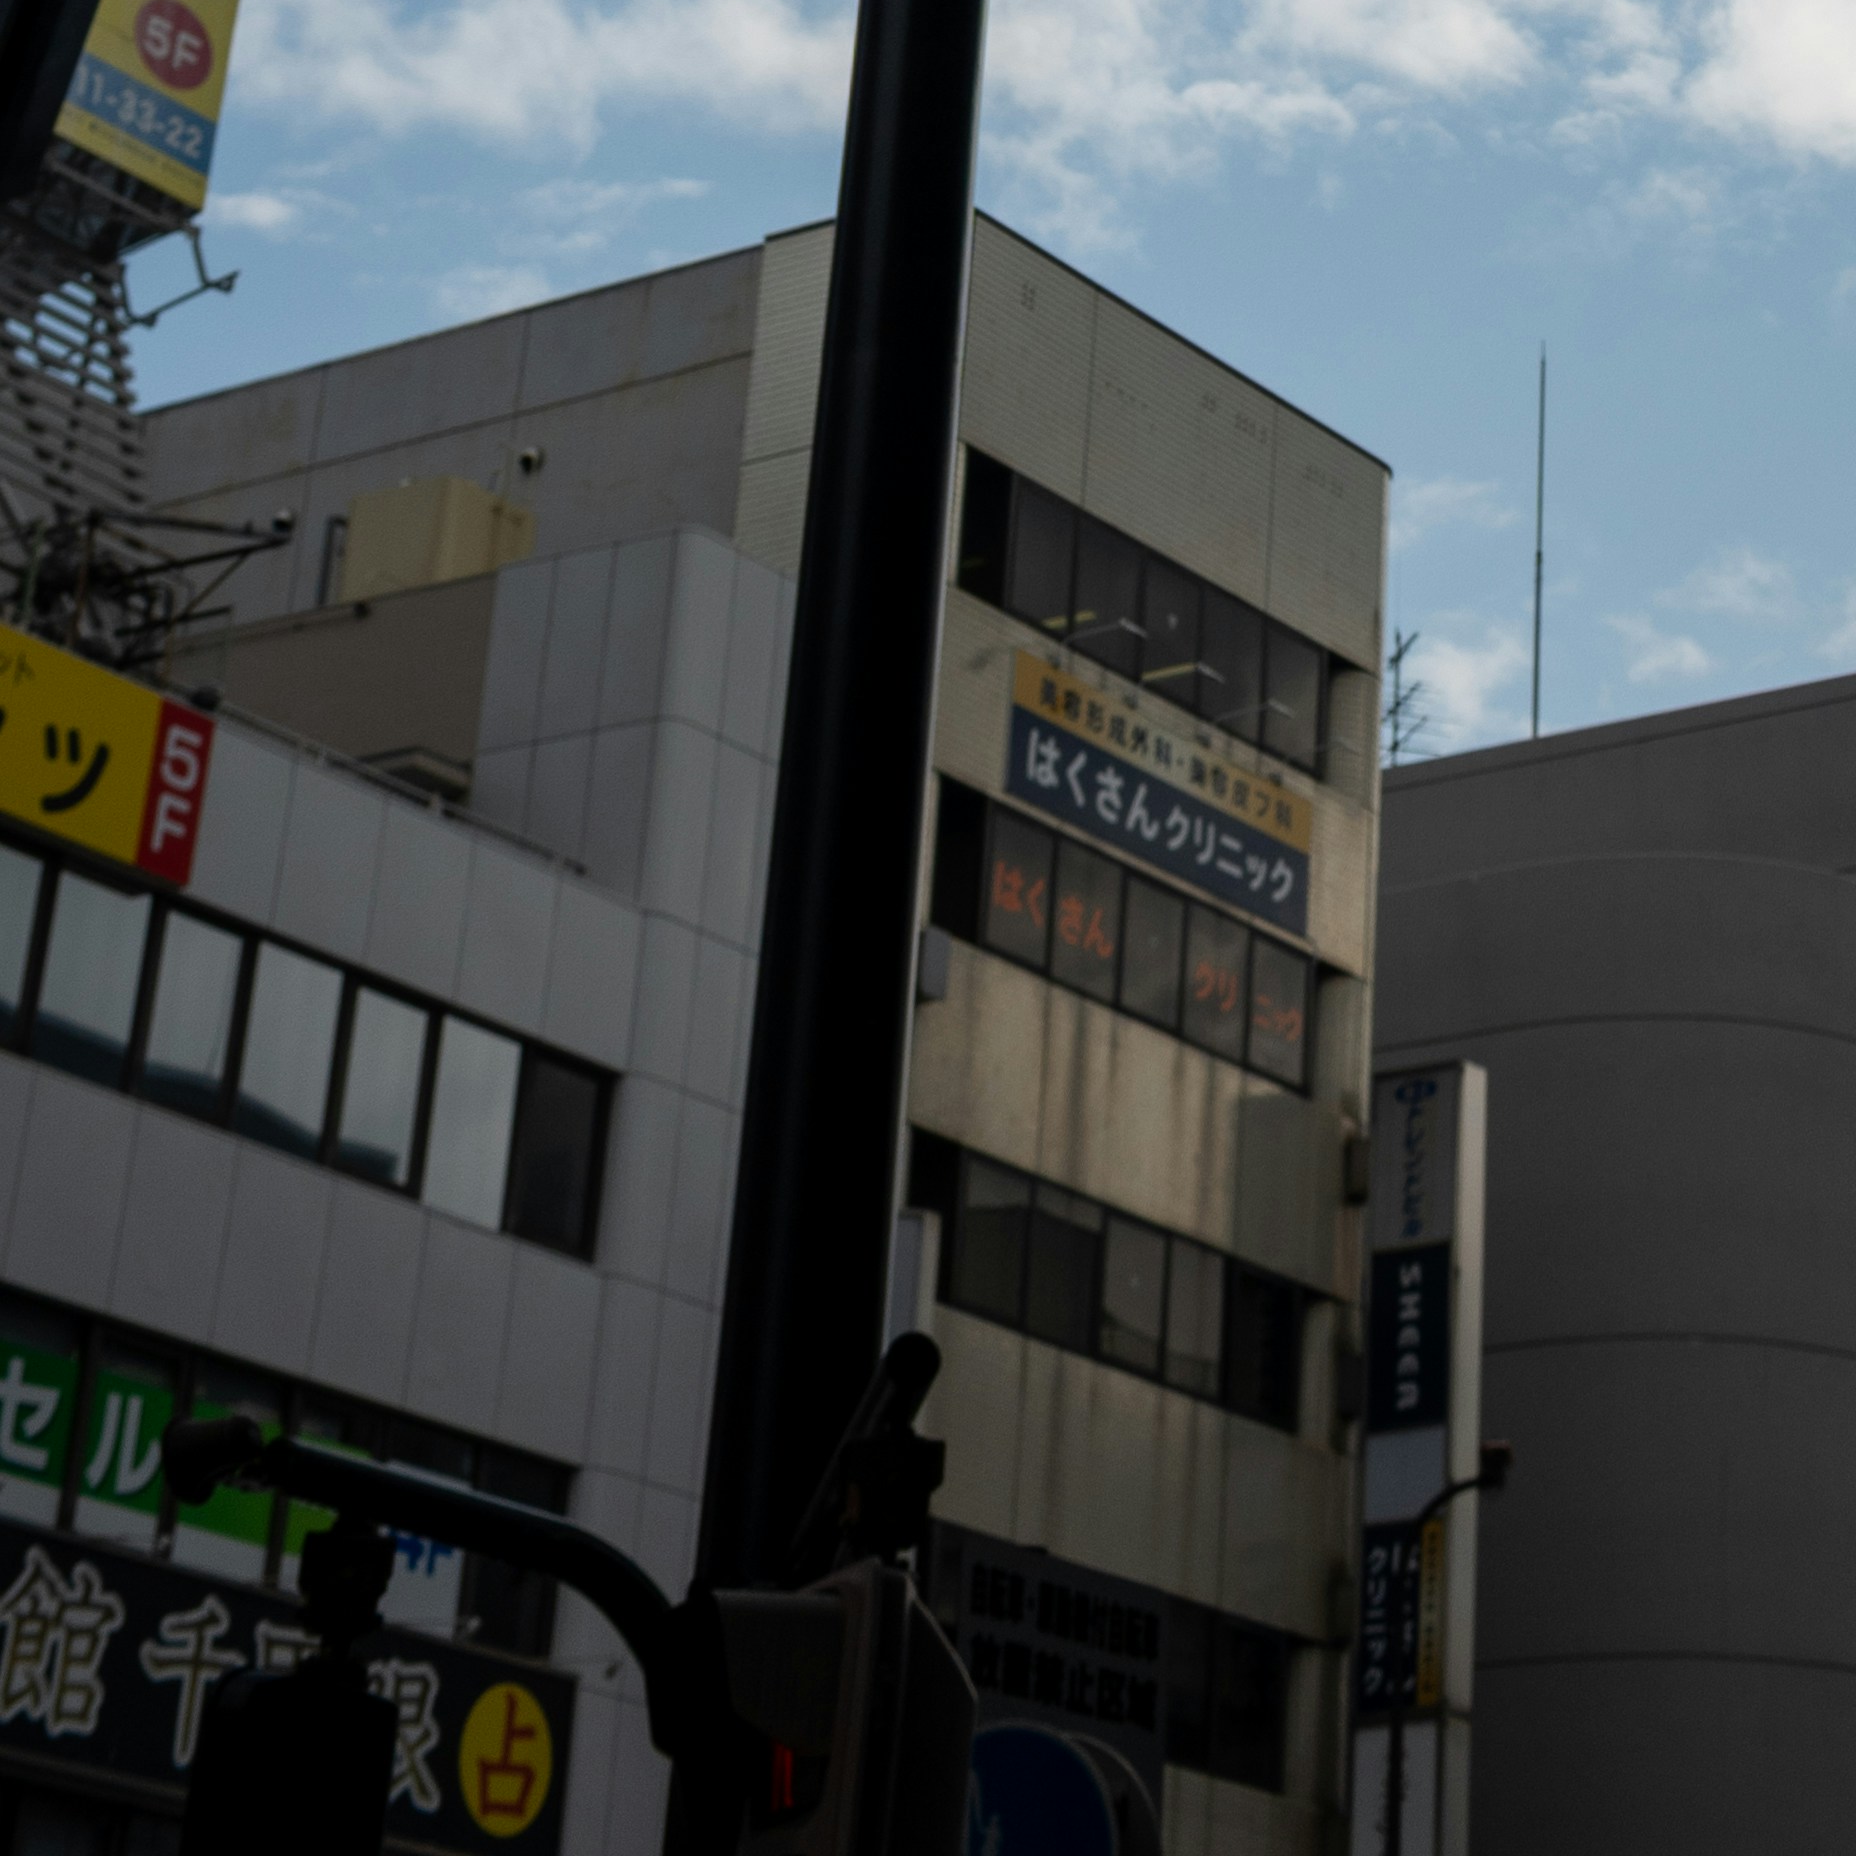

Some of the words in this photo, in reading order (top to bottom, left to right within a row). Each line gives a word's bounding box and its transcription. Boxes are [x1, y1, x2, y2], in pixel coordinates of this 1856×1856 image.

[143, 25, 203, 71] 5F
[151, 723, 204, 854] 5F
[1024, 726, 1294, 904] はくさんクリニック
[476, 1691, 537, 1818] 占
